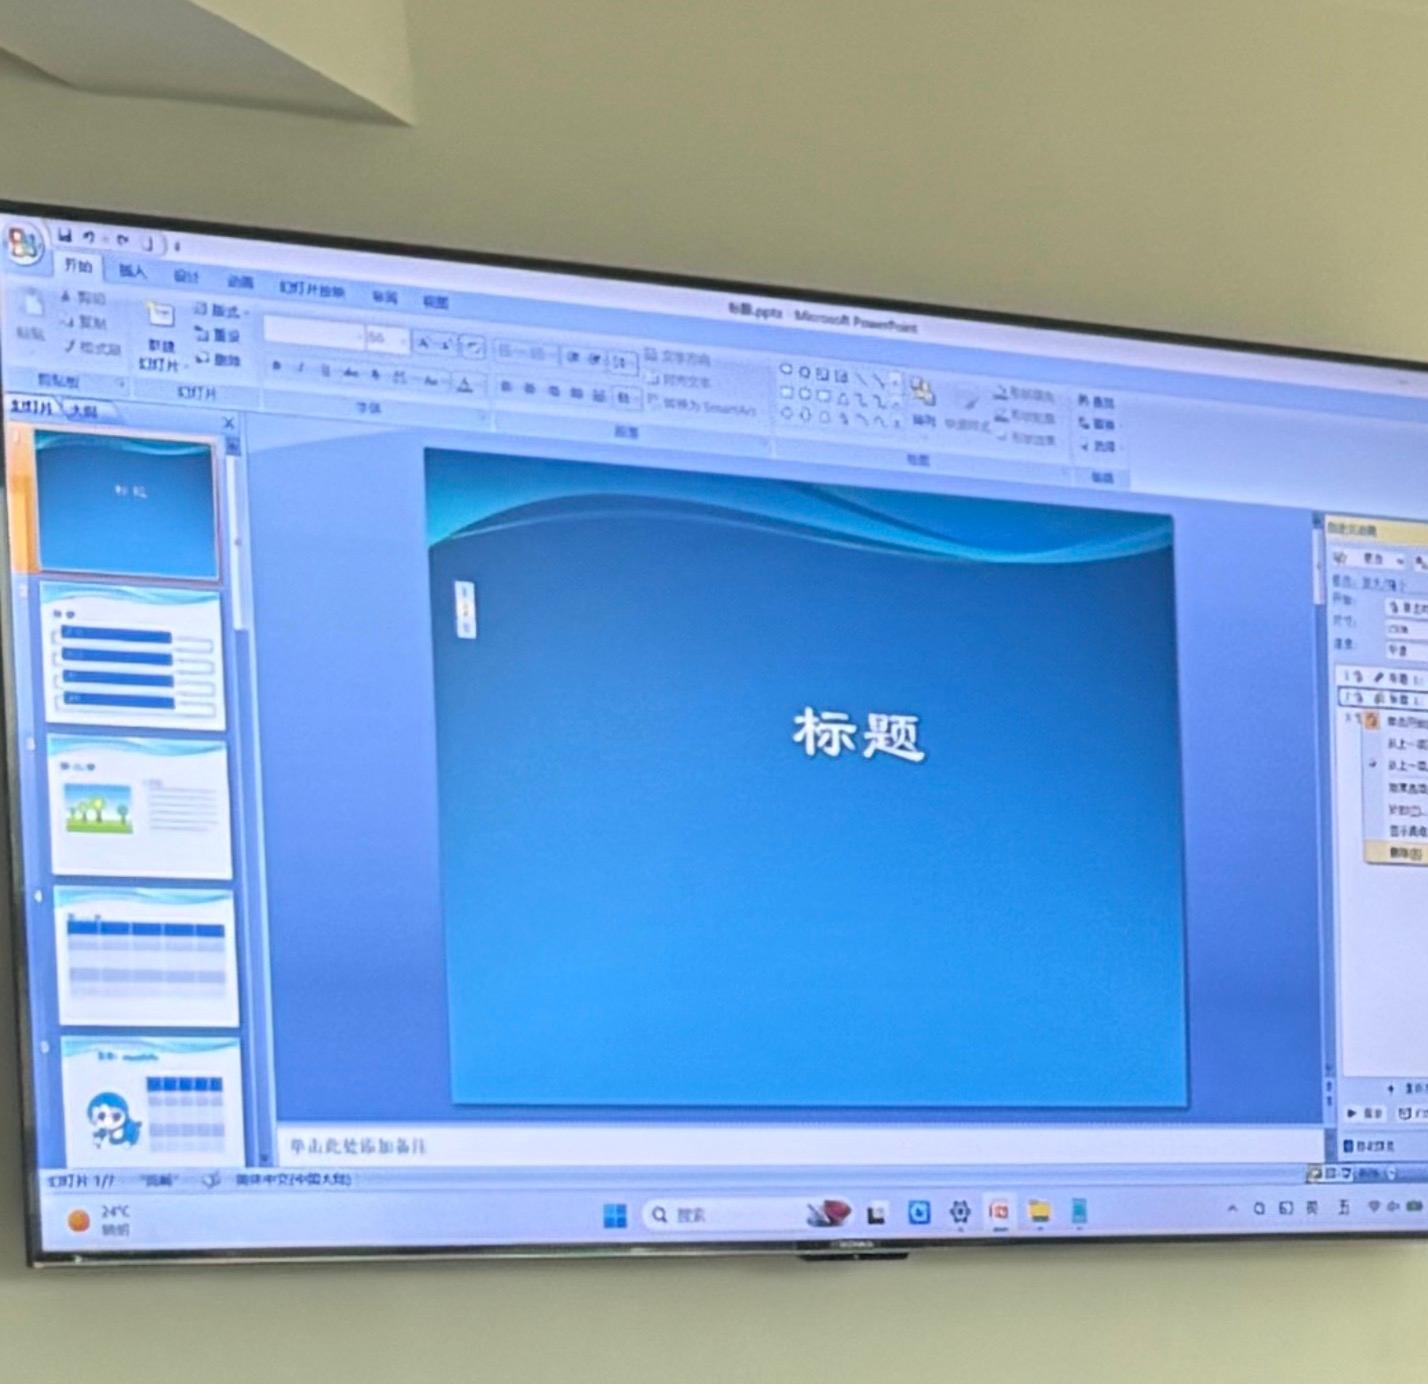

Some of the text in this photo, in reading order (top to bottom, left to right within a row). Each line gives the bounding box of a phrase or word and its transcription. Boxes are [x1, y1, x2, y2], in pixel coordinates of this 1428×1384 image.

[65, 258, 93, 273] 开始
[794, 310, 850, 327] Microsoft
[853, 315, 918, 334] PowerPoint
[793, 706, 925, 762] 标题
[290, 1136, 428, 1156] 单击此处添加备注
